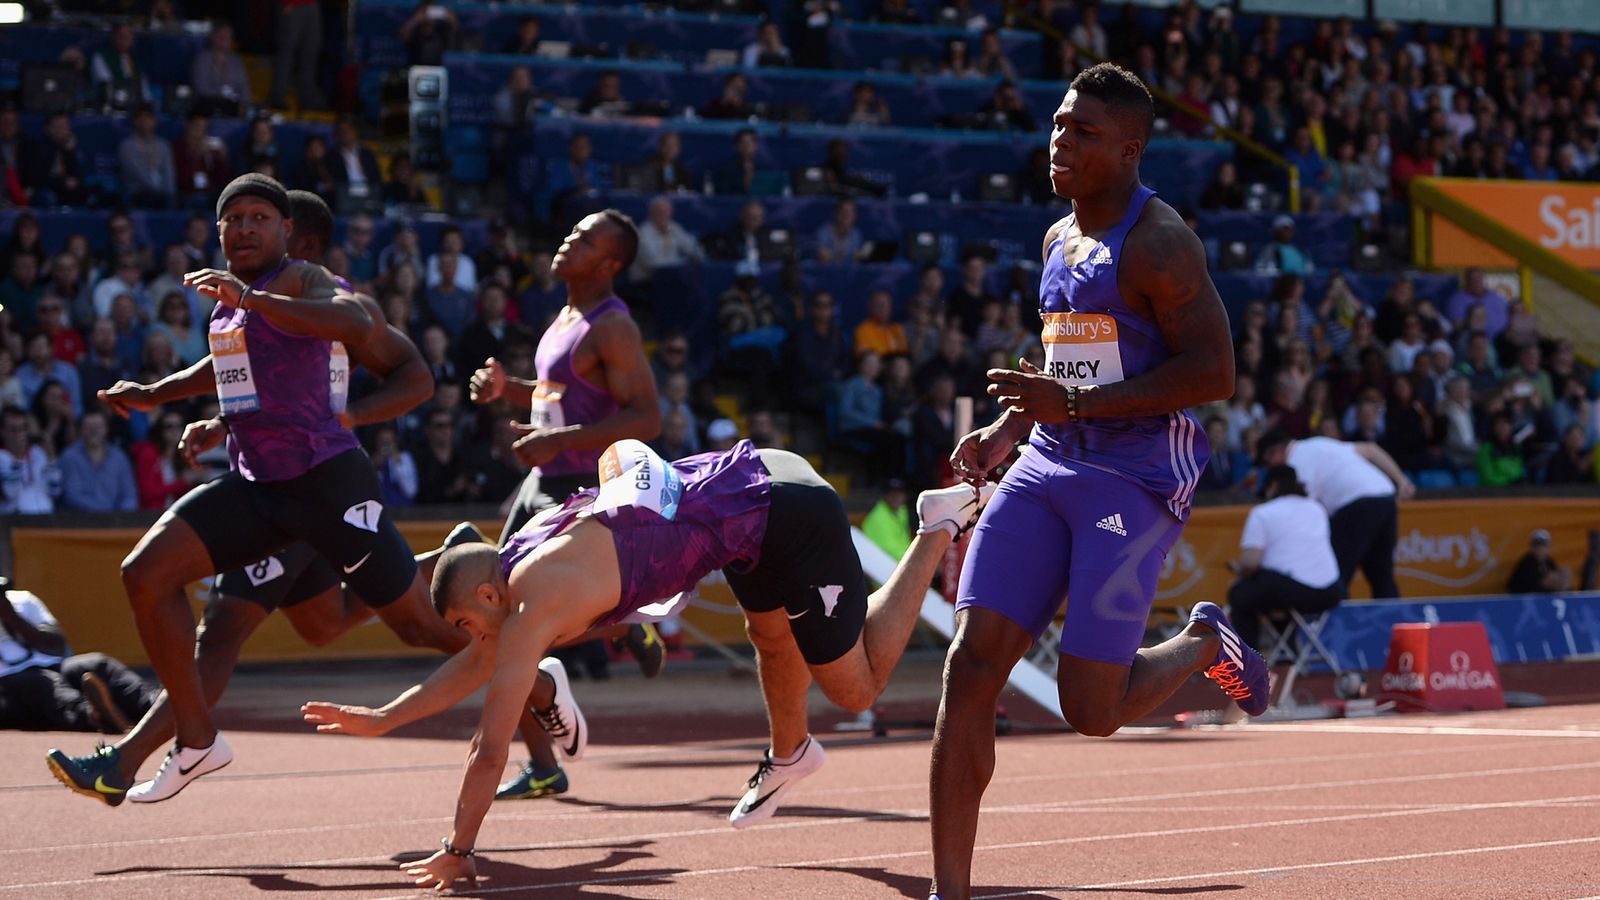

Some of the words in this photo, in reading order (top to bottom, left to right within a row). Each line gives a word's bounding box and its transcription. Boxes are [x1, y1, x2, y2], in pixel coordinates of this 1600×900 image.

[1049, 360, 1101, 379] BRACY
[355, 504, 371, 528] 7
[1095, 519, 1128, 537] adidas
[252, 558, 270, 580] 8
[1429, 670, 1496, 692] OMEGA
